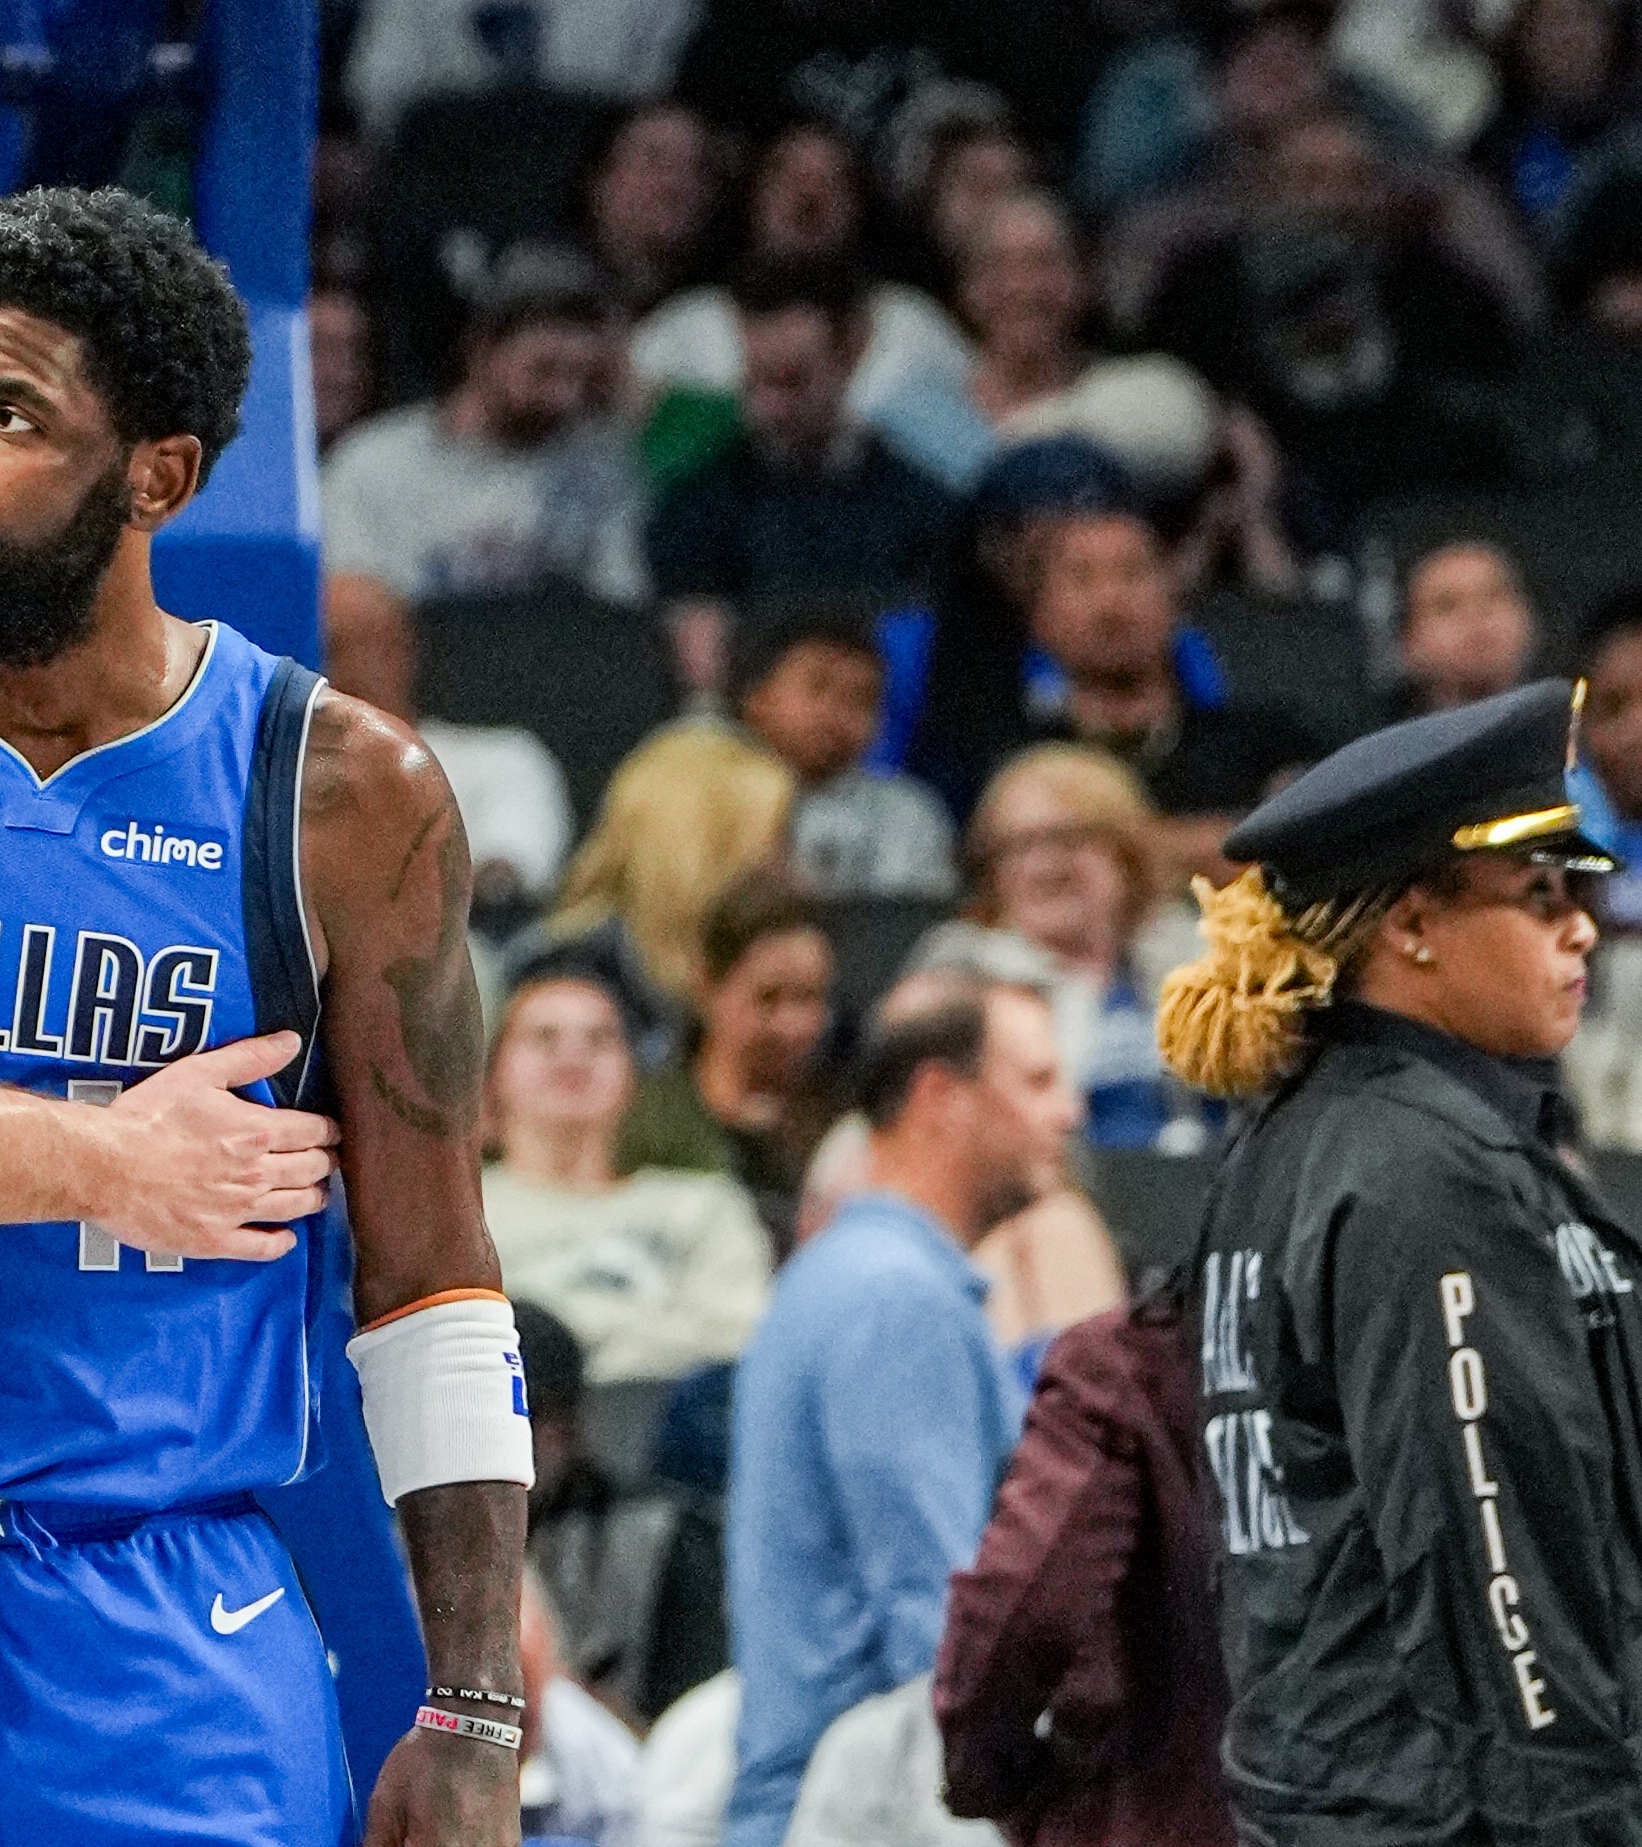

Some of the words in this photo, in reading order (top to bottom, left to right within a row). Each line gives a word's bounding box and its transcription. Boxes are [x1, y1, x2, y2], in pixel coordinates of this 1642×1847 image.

[100, 821, 224, 870] chime
[1441, 1271, 1556, 1730] POLICE
[460, 1688, 483, 1700] KAI
[463, 1719, 503, 1740] FREE
